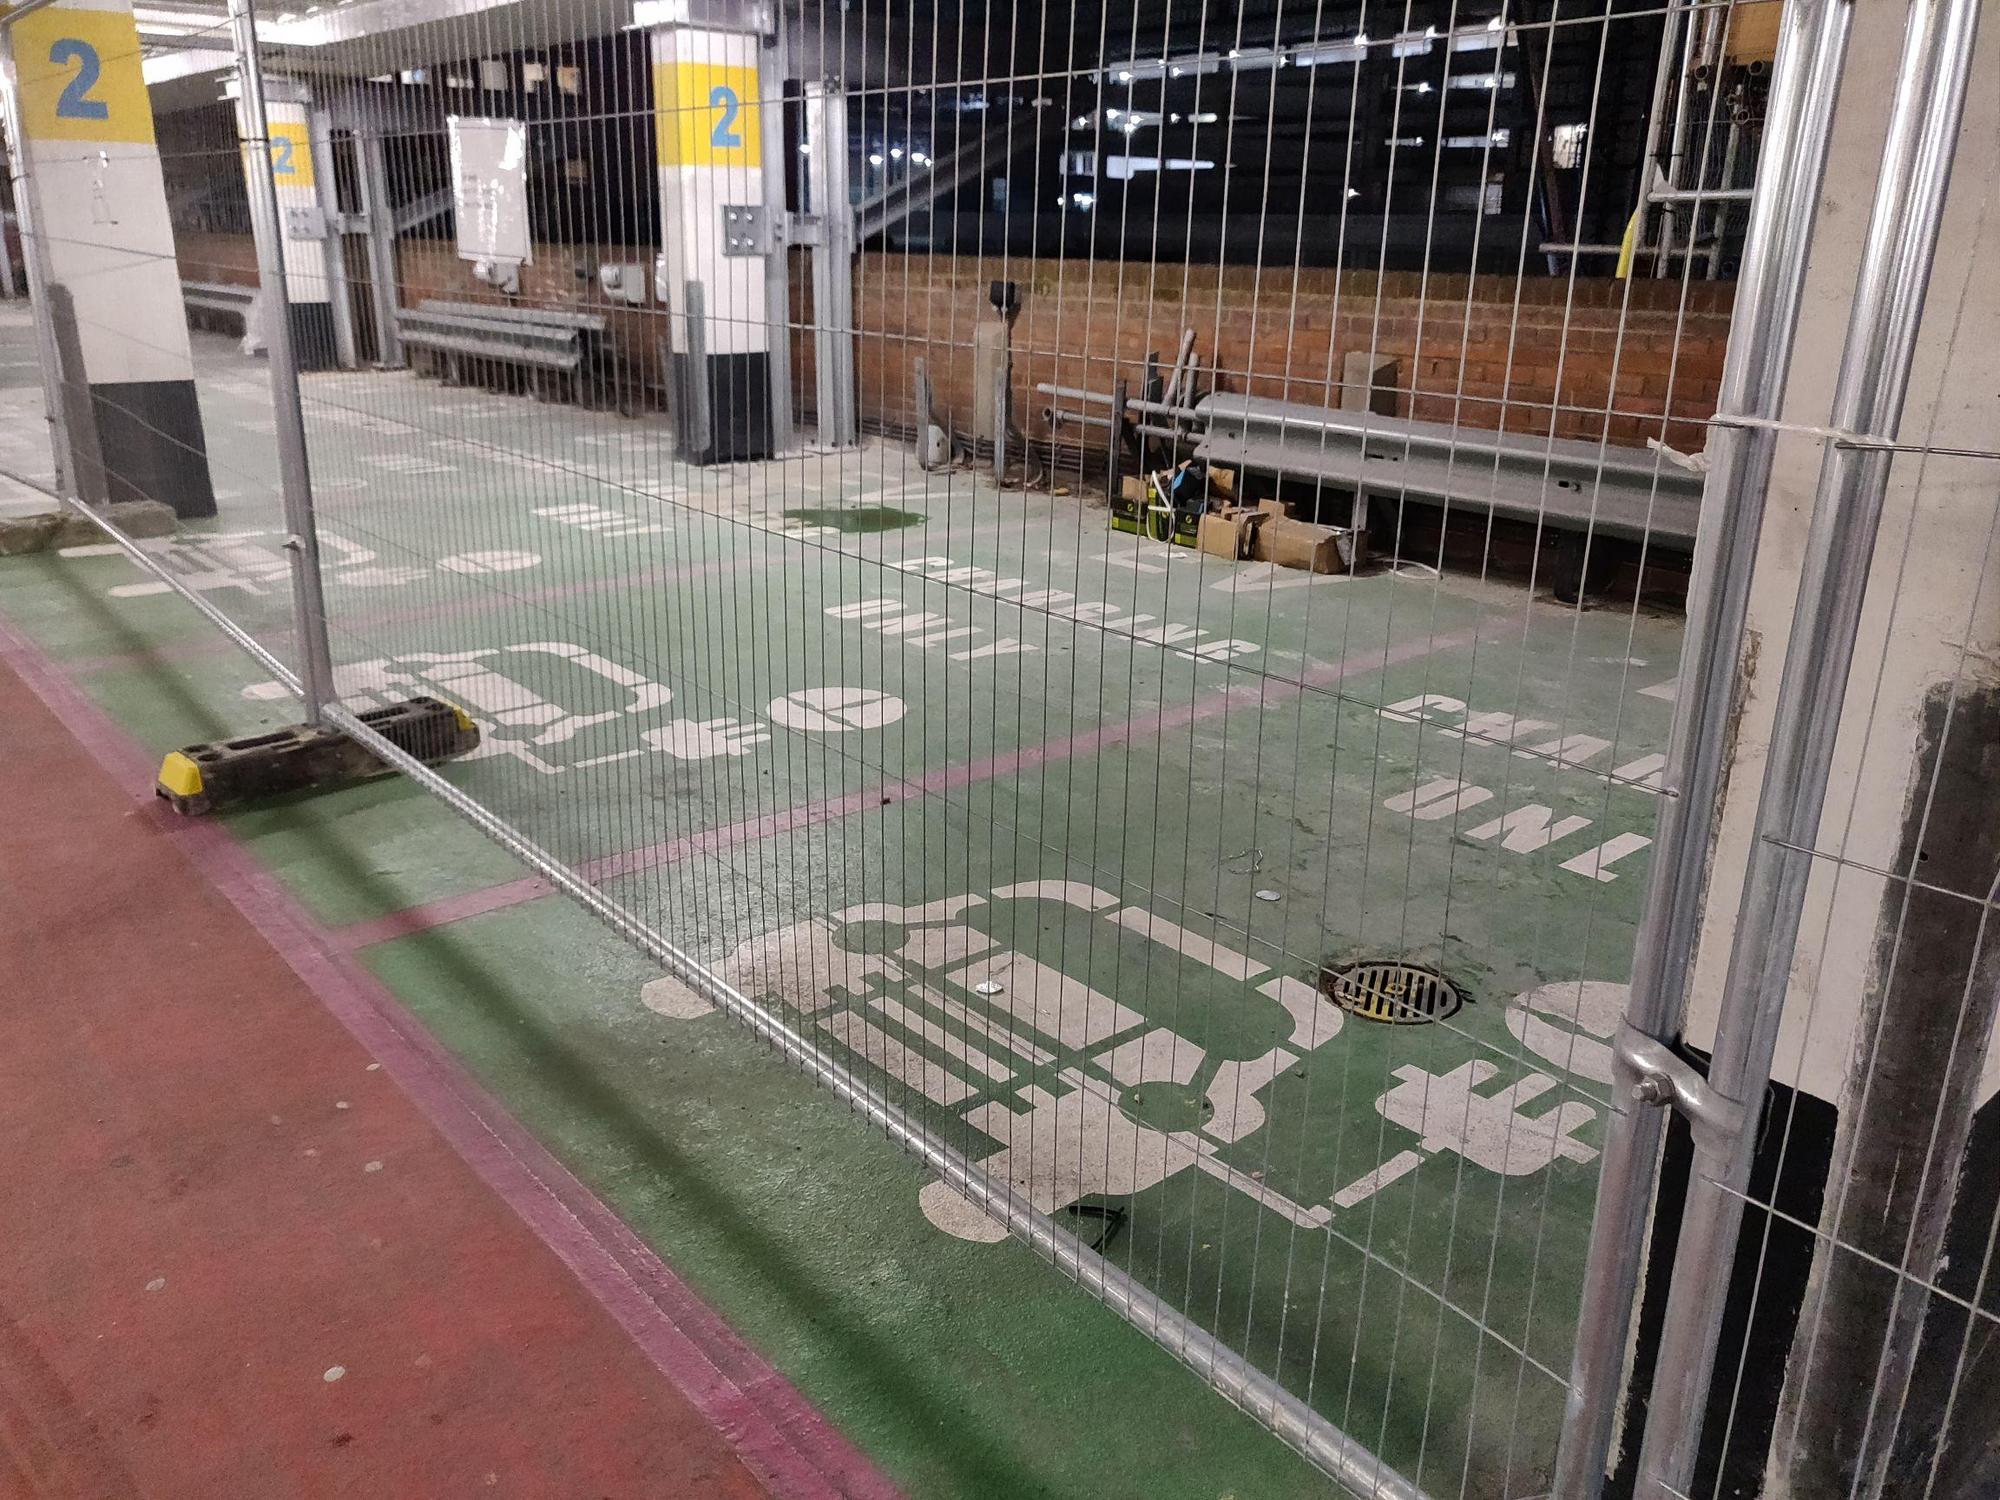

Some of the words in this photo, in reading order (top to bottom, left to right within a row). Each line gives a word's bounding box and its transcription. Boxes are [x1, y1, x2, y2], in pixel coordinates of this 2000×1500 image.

[49, 39, 109, 119] 2
[709, 86, 742, 148] 2
[271, 136, 296, 174] 2
[823, 599, 1040, 661] ONLY
[885, 556, 1261, 664] CHARGING
[1383, 778, 1653, 883] ONL
